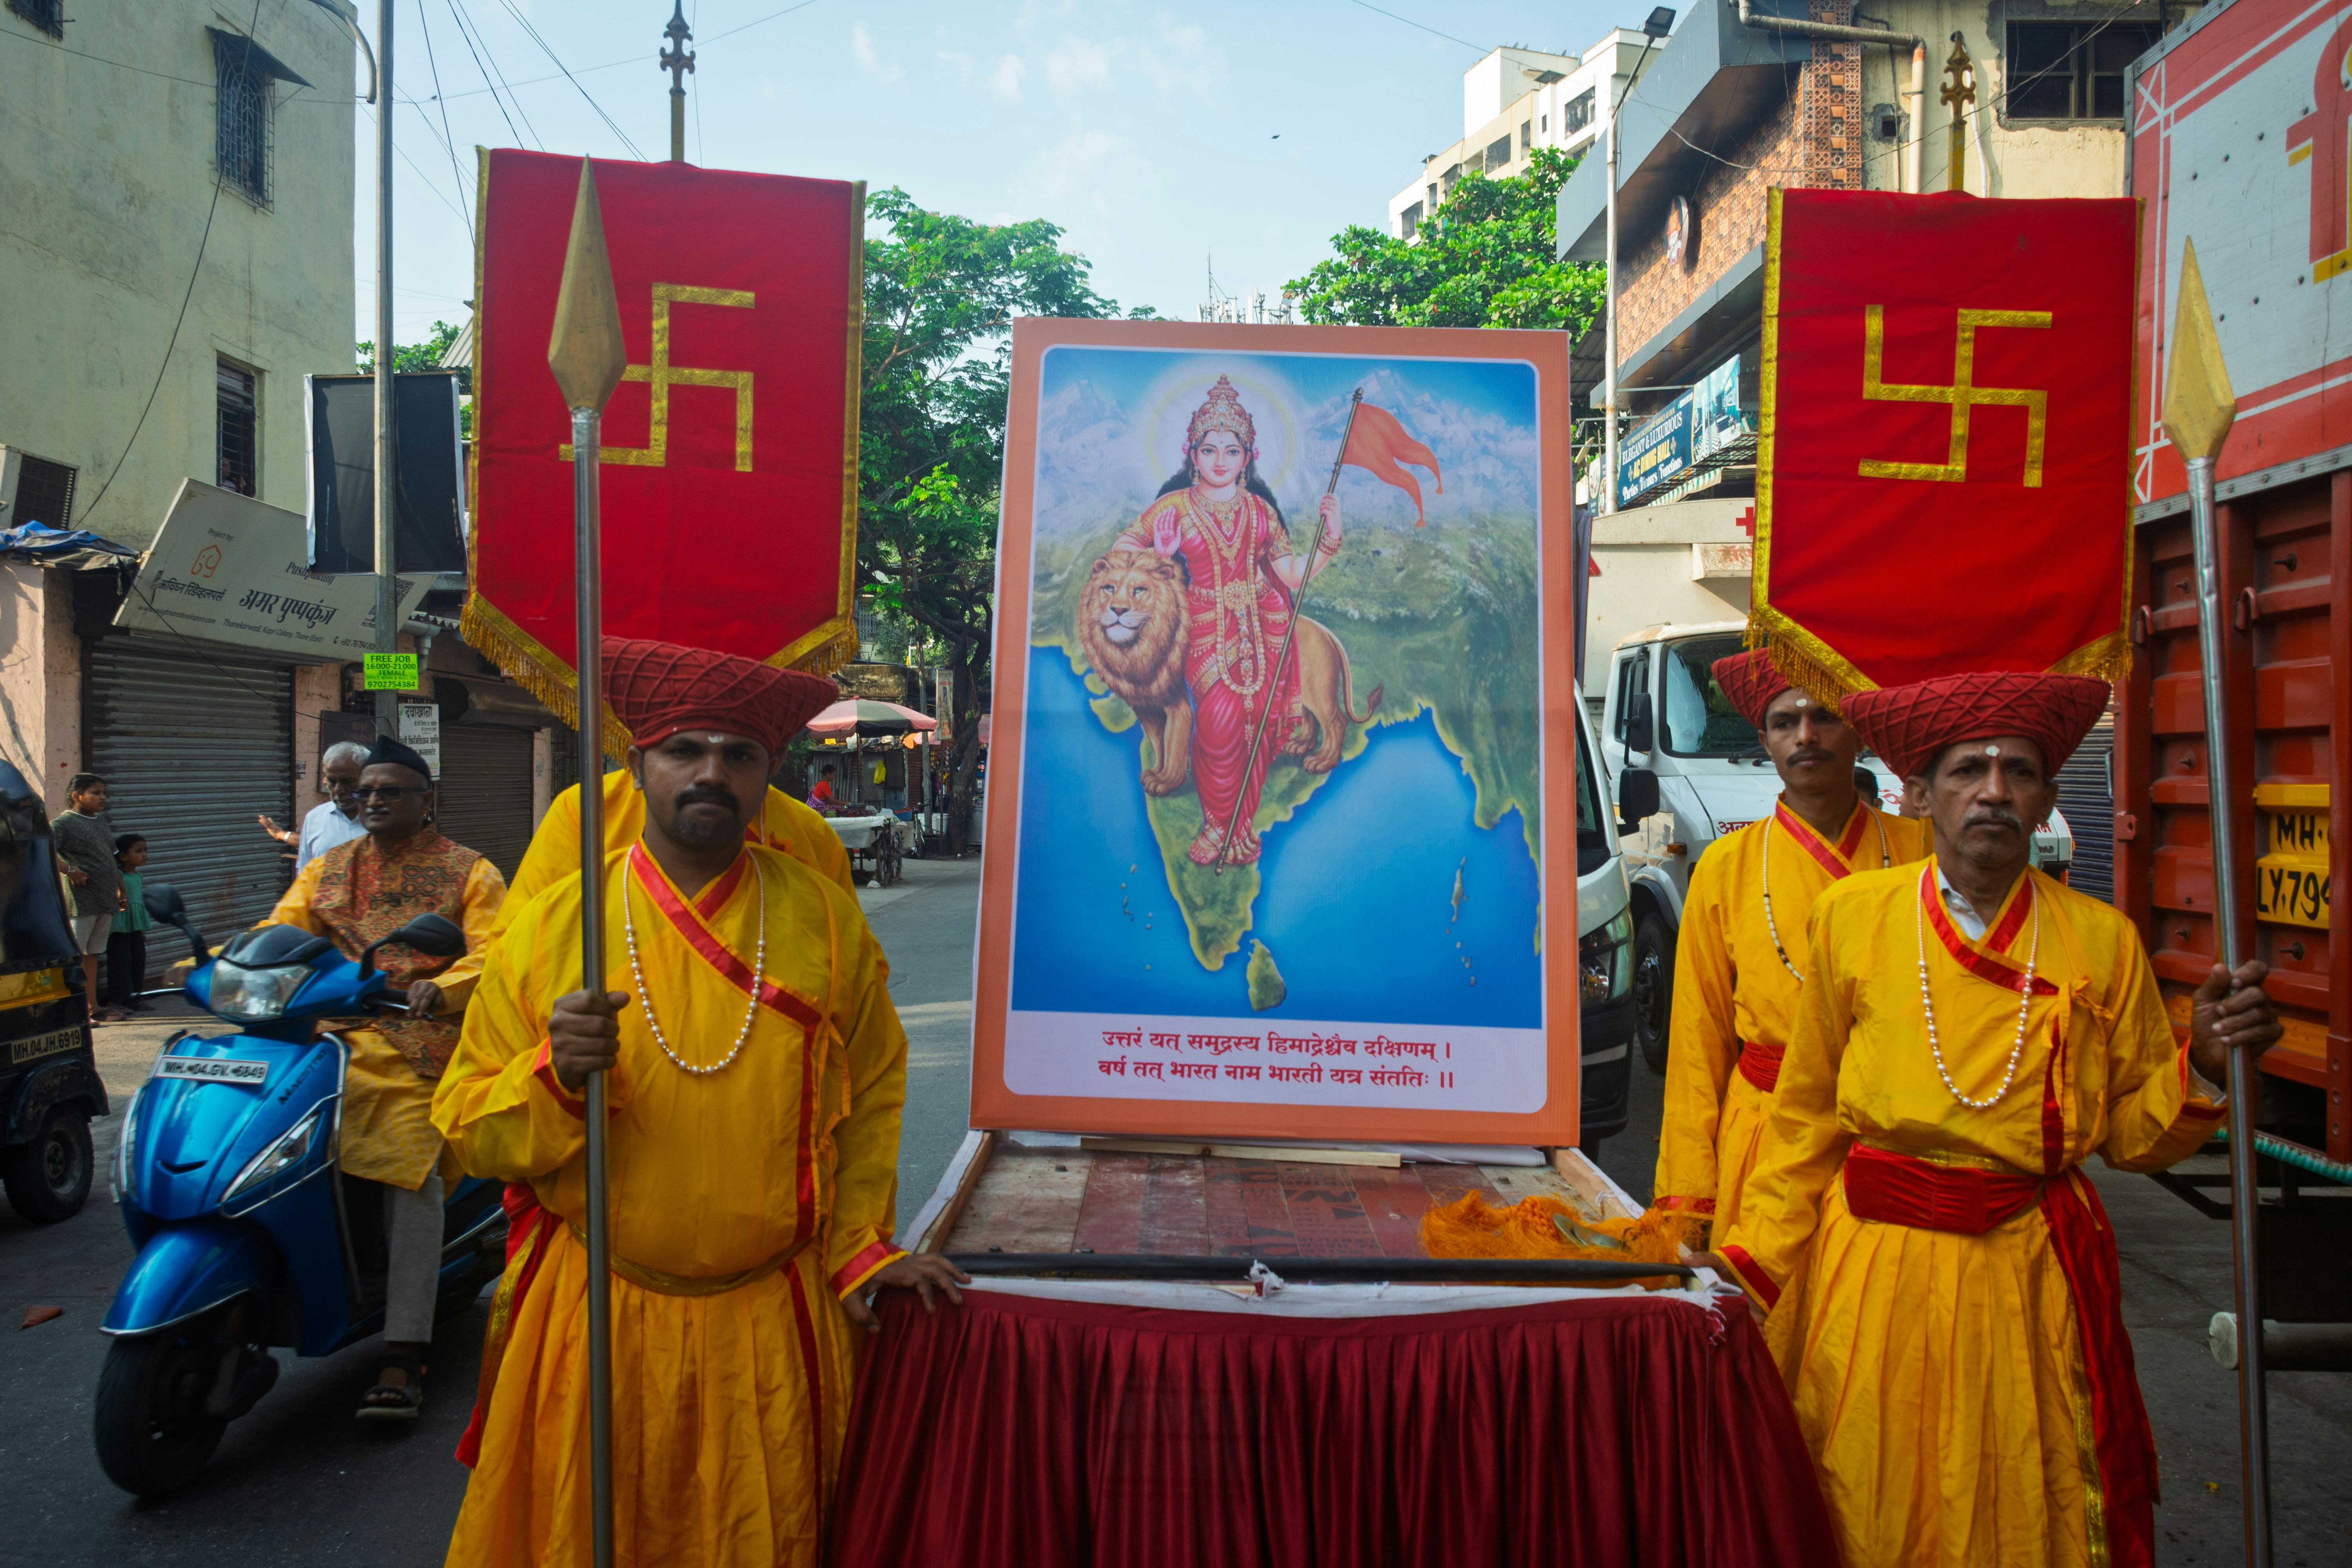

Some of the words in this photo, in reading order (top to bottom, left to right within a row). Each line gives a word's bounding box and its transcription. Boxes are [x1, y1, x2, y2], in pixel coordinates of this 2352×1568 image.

[1622, 438, 1645, 466] ELEGANT
[1645, 435, 1650, 449] &
[1650, 411, 1682, 446] LUXURIOUS
[1633, 459, 1640, 479] AC
[1641, 448, 1657, 474] DINING
[1657, 439, 1671, 464] HALL
[1622, 484, 1638, 501] Parties
[1659, 456, 1683, 479] Functions
[208, 528, 227, 540] Project
[239, 589, 282, 614] अमर
[277, 597, 339, 629] पुष्पकुंज
[295, 632, 310, 641] Thane
[405, 706, 433, 720] दवाखाना
[13, 1029, 81, 1061] MH.04.JH.6919
[1102, 1026, 1143, 1048] उत्तरं
[1149, 1033, 1183, 1054] यत्
[1187, 1034, 1261, 1056] समुद्रस्य
[1363, 1035, 1439, 1063] दक्षिणम्
[1098, 1055, 1127, 1076] वर्ष
[1133, 1062, 1166, 1083] तत्
[1170, 1061, 1218, 1080] भारत
[1224, 1065, 1262, 1081] नाम
[1268, 1062, 1323, 1083] भारती
[1329, 1068, 1363, 1085] यत्र
